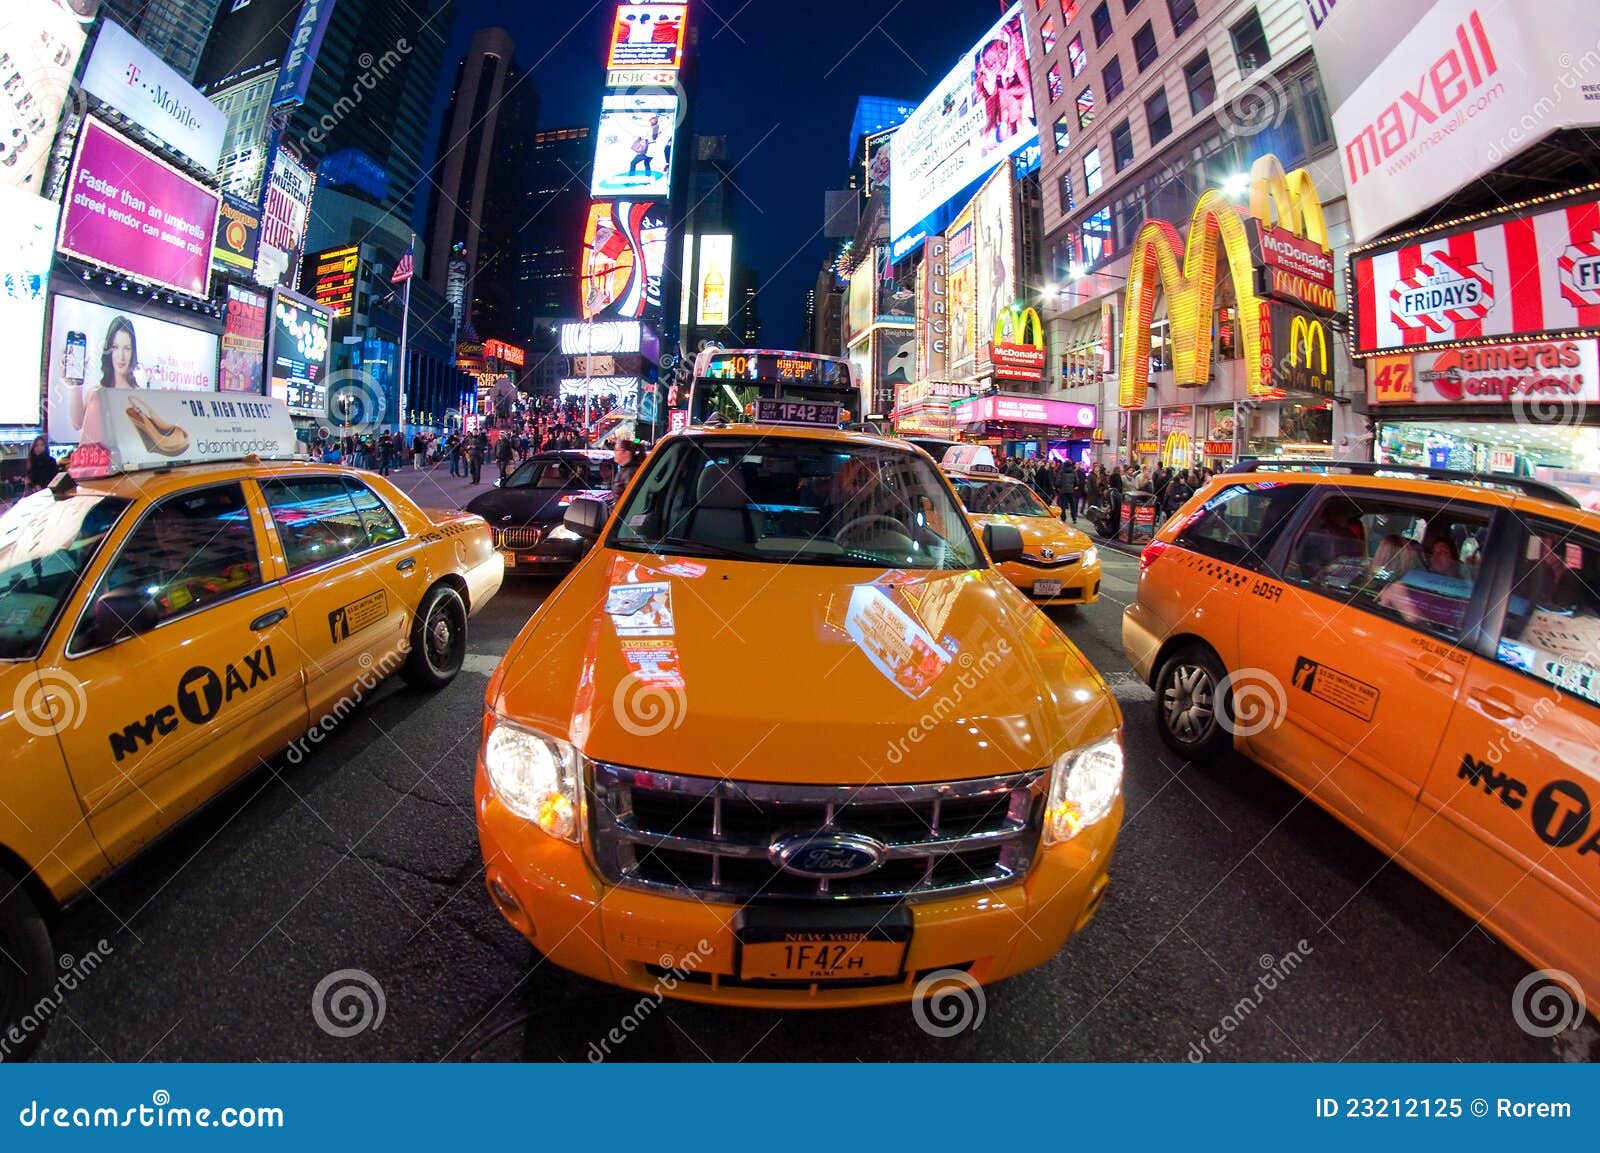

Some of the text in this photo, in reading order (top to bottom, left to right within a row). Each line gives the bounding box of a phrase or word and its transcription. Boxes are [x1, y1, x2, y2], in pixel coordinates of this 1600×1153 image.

[609, 73, 651, 84] HSBC
[1345, 9, 1498, 185] maxell
[1387, 83, 1505, 176] www.maxell.com
[283, 168, 303, 189] BEST
[272, 173, 307, 207] MUSICAL
[79, 168, 205, 240] Faster than an umbrella
[268, 187, 294, 225] BILLY
[74, 193, 106, 215] street
[107, 206, 142, 229] vendor
[142, 223, 160, 237] can
[160, 231, 186, 249] sense
[220, 203, 258, 229] Avenue
[226, 220, 247, 253] Q
[1264, 235, 1333, 273] McDonald's
[1277, 256, 1325, 280] Restaurant
[228, 300, 264, 316] ONE
[933, 245, 946, 353] PALACE
[995, 347, 1043, 359] McDonald's
[777, 360, 812, 370] MIDTOWN
[782, 369, 805, 378] 42 ST
[211, 401, 236, 417] HIGH
[761, 411, 776, 419] DUTY
[763, 402, 776, 410] OFF
[780, 404, 817, 420] 1F42
[820, 406, 834, 414] OFF
[819, 414, 834, 423] DUTY
[1492, 451, 1513, 467] ATM
[108, 704, 179, 762] NYC
[1457, 753, 1528, 811] NYC
[803, 848, 854, 871] Ford
[784, 933, 868, 942] NEW YORK
